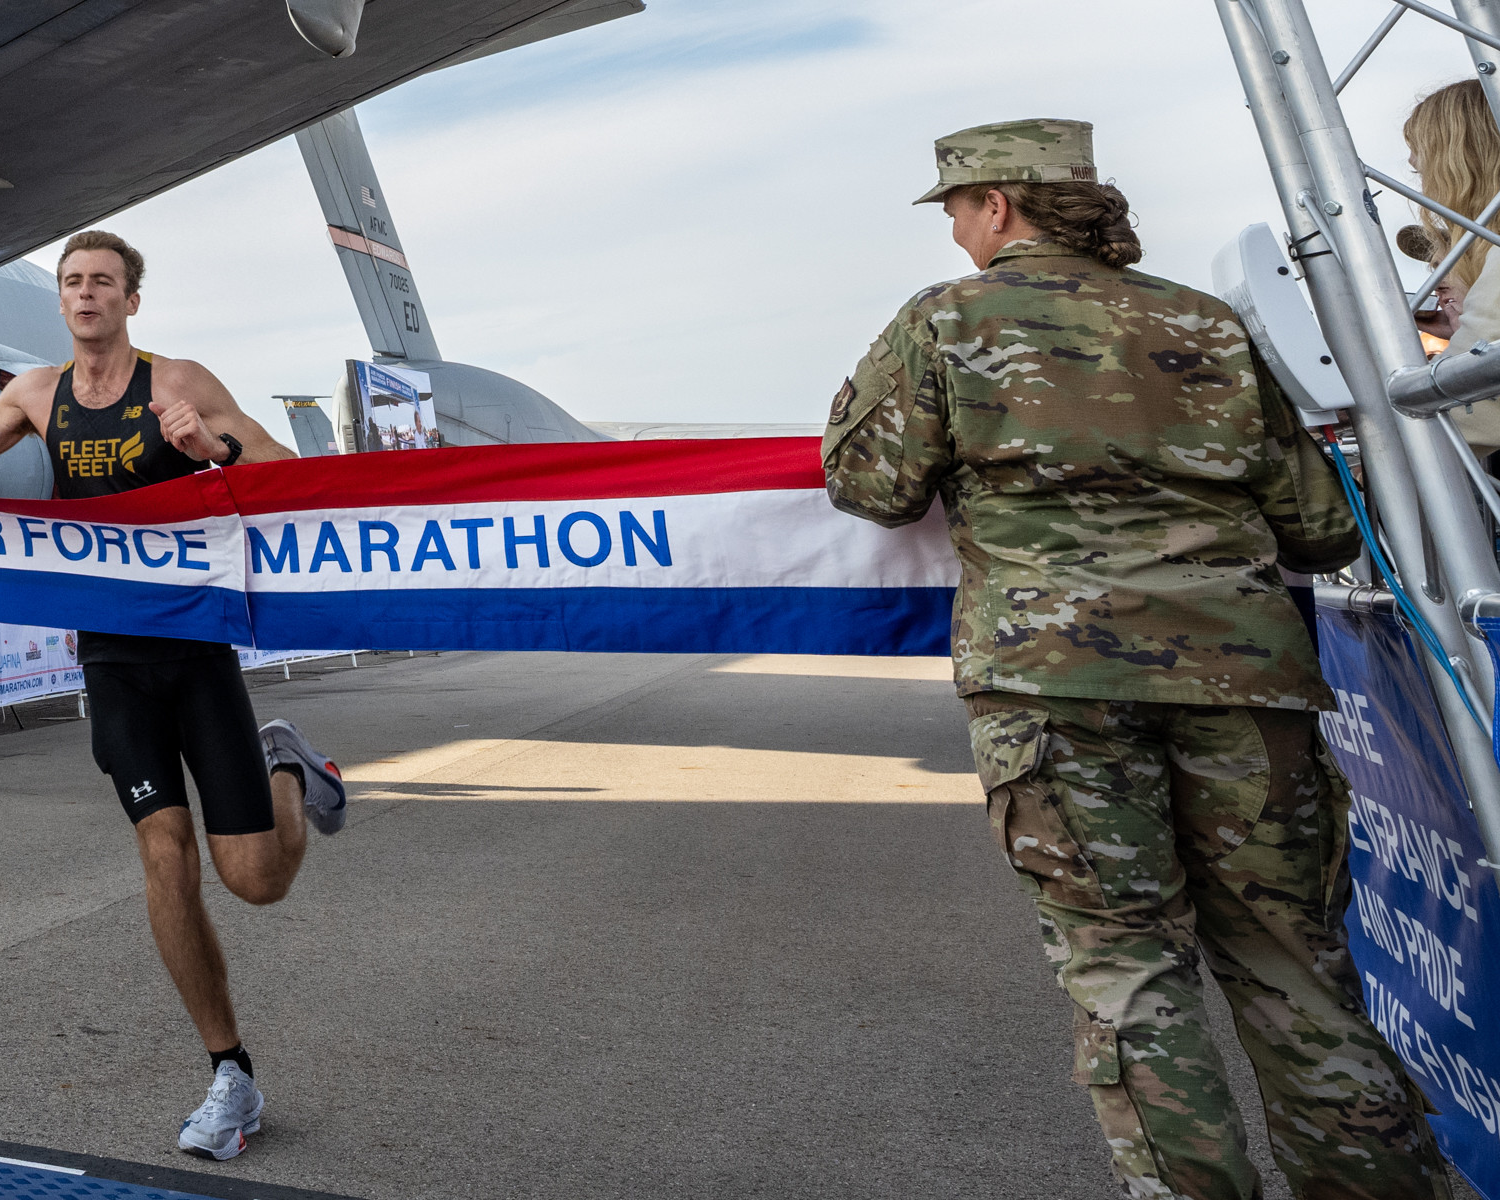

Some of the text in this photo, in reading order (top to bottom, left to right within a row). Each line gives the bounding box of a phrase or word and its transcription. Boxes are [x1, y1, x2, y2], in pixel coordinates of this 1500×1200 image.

[370, 216, 387, 236] AFMC
[403, 301, 419, 333] ED
[59, 438, 121, 460] FLEET
[67, 457, 116, 478] FEET
[17, 517, 211, 571] FORCE
[250, 509, 674, 574] MARATHON
[1352, 878, 1476, 1031] AND PRIDE
[1365, 970, 1429, 1079] TAKE
